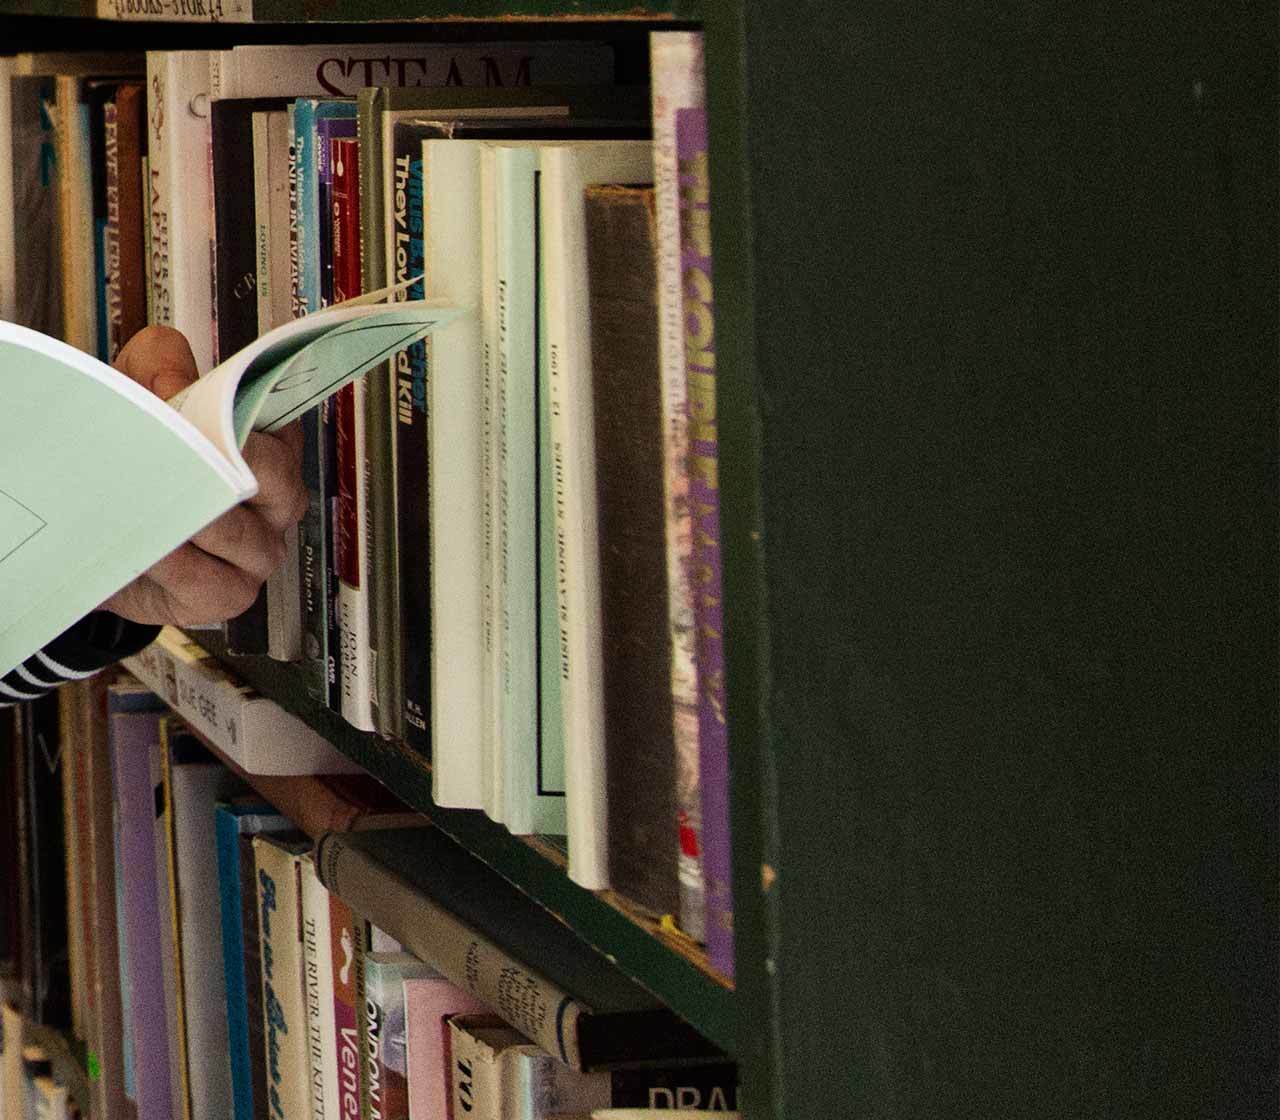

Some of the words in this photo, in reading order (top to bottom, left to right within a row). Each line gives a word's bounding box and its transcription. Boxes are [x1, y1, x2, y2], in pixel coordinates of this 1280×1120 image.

[316, 55, 536, 98] STEAM
[106, 122, 119, 176] FAYE
[395, 155, 410, 233] They
[107, 185, 123, 324] KELLERMAN
[159, 212, 169, 283] PETER
[397, 236, 410, 304] Love
[400, 384, 412, 426] Kill
[303, 544, 314, 612] Philpott
[346, 629, 359, 679] JOAN
[306, 918, 316, 958] THE
[311, 1024, 322, 1064] THE
[366, 999, 380, 1102] ONDON
[313, 1067, 326, 1120] KETT
[339, 1026, 358, 1120] Vene
[647, 1085, 728, 1110] DRA
